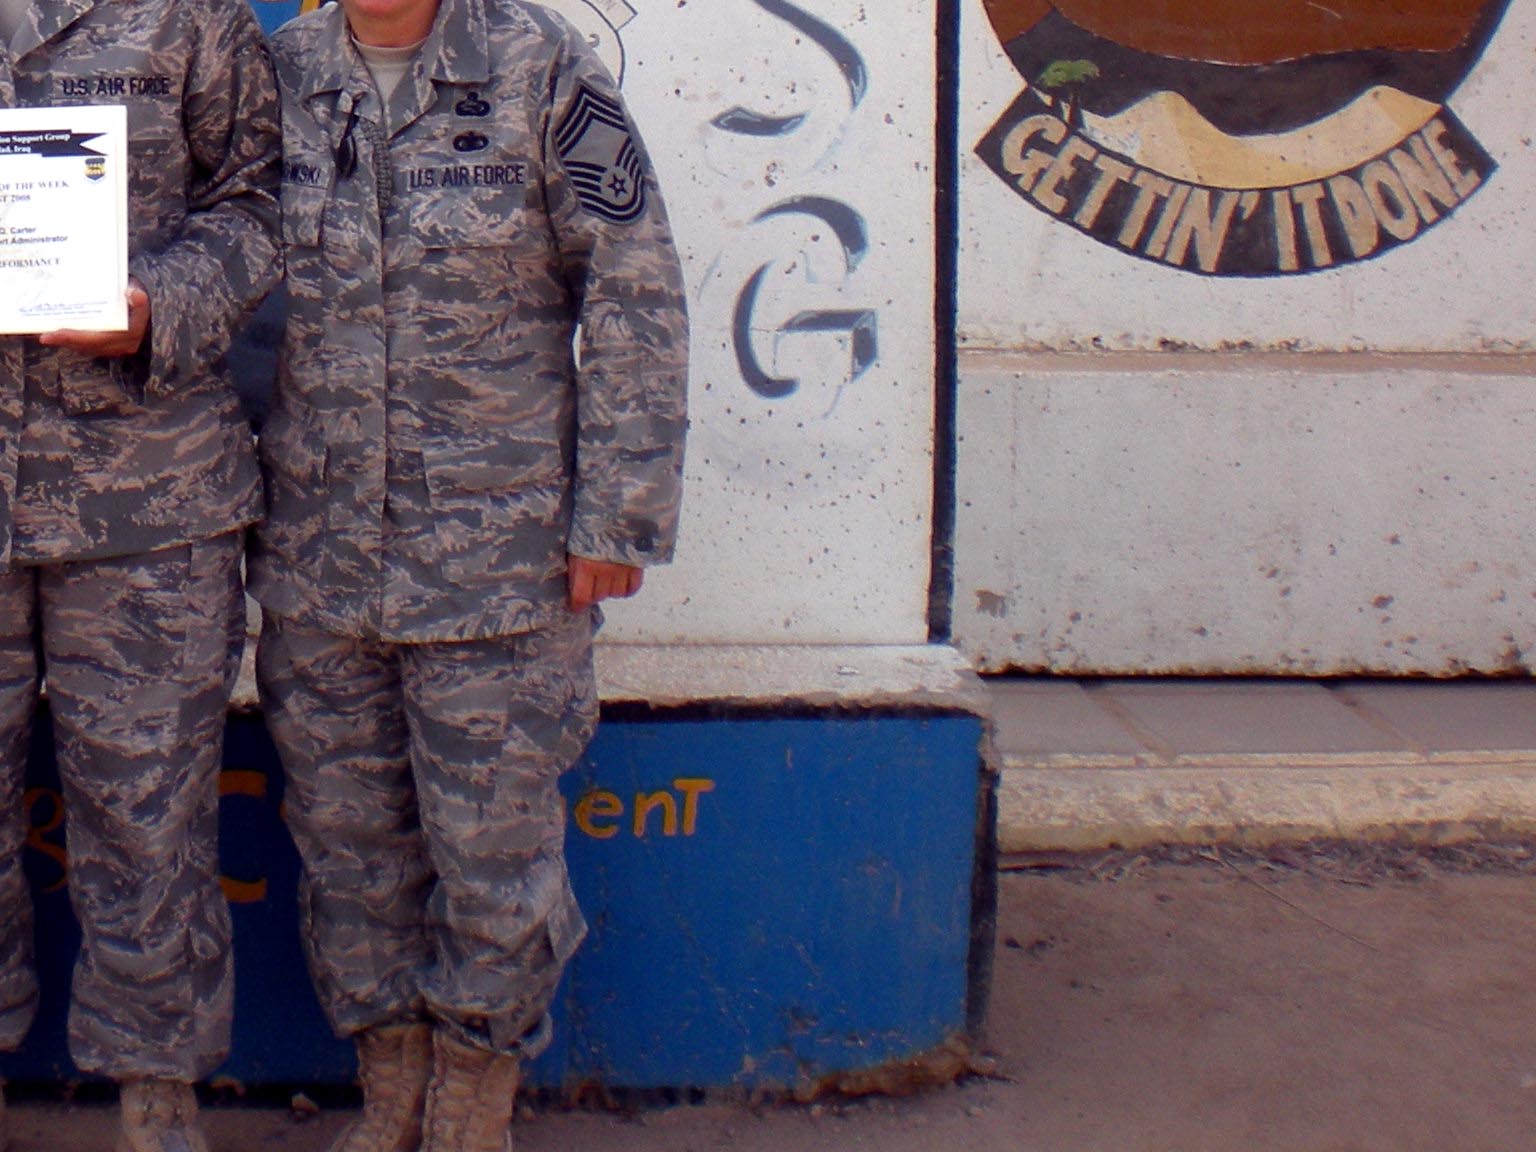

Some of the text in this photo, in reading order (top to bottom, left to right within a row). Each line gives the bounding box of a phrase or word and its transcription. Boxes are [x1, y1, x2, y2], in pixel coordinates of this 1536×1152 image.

[63, 76, 171, 97] U.S. AIR FORCE
[12, 134, 43, 146] Support
[44, 132, 71, 143] Group
[441, 165, 470, 188] AIR
[474, 163, 525, 186] FORCE
[15, 181, 34, 191] THE
[38, 180, 70, 190] WEEK
[1000, 113, 1481, 274] GETTIN' IT DONE
[10, 226, 37, 236] Carter
[10, 234, 68, 246] Administrator
